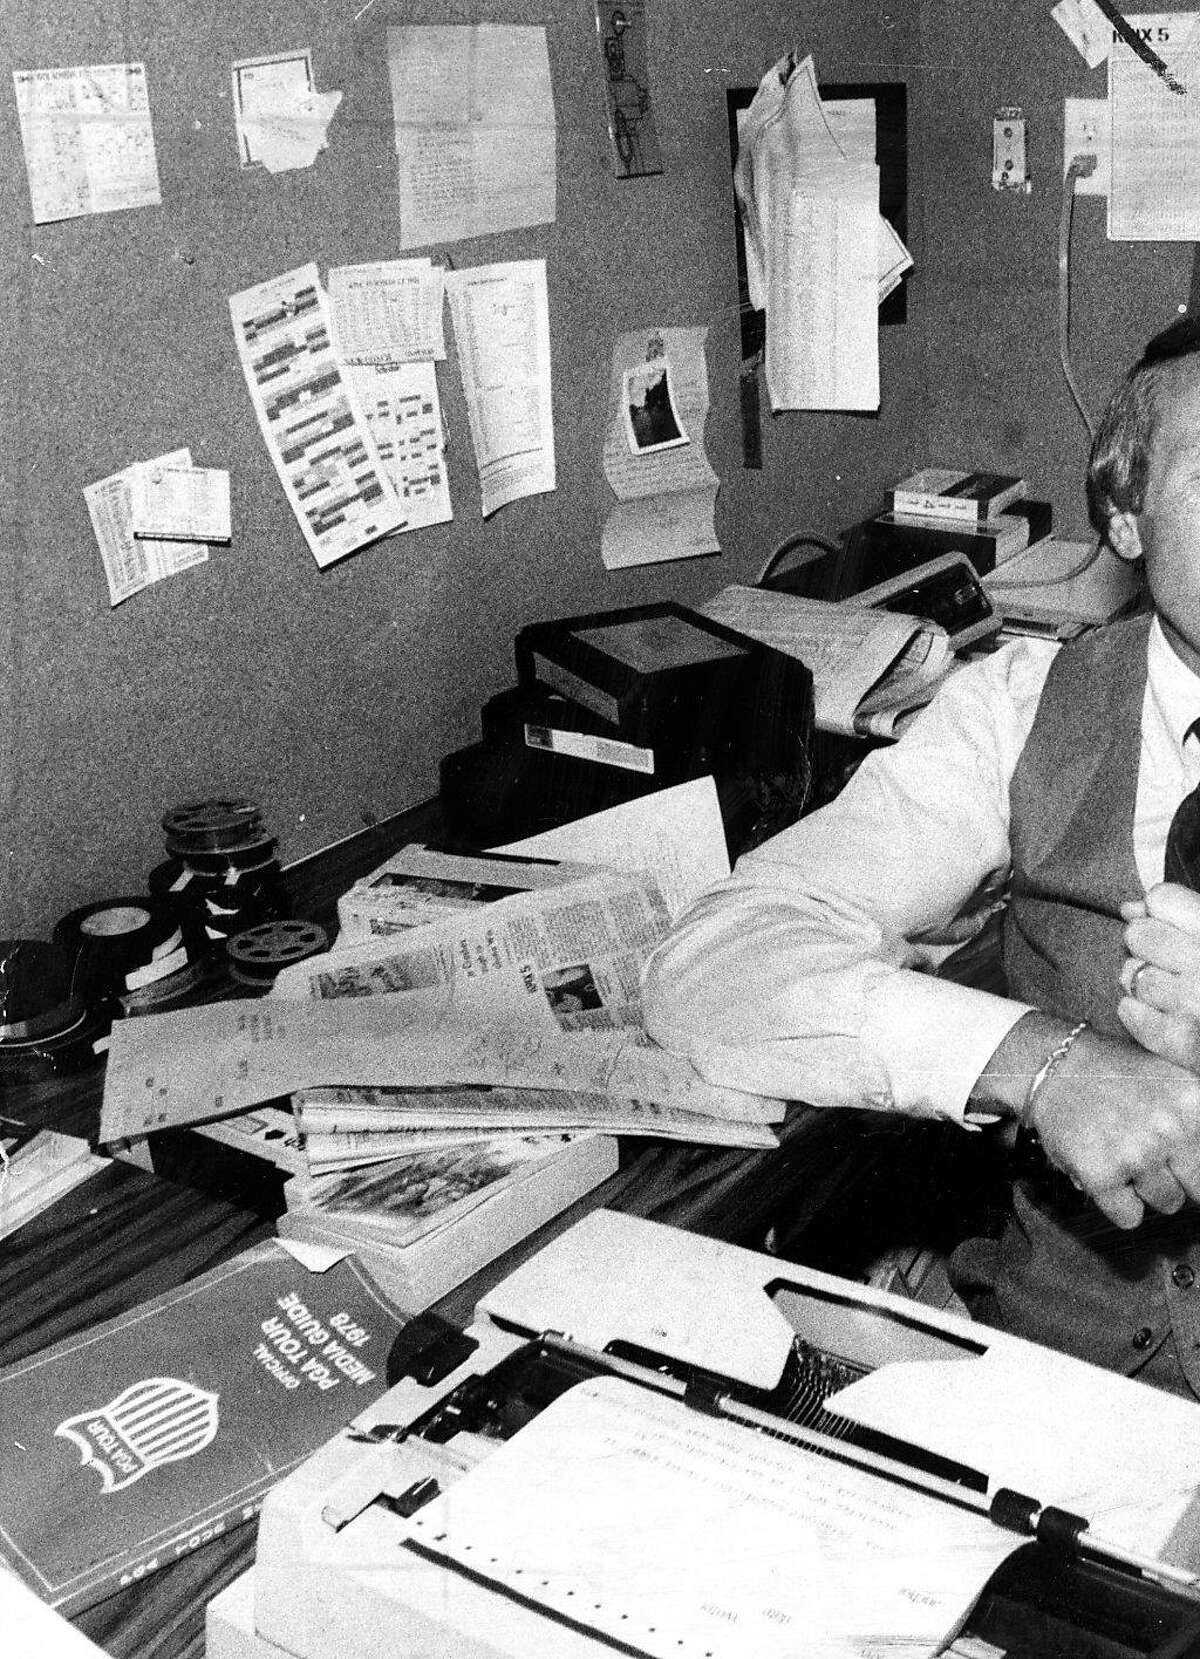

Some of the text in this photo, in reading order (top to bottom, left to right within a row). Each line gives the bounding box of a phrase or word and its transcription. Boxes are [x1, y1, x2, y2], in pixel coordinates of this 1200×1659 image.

[1112, 27, 1170, 43] KX 5
[261, 1315, 340, 1390] PGA TOUR
[277, 1291, 377, 1385] MEDIA GUIDE
[330, 1312, 371, 1348] 1978
[252, 1343, 300, 1389] OFFICIAL
[86, 1419, 139, 1474] PGA TOUR
